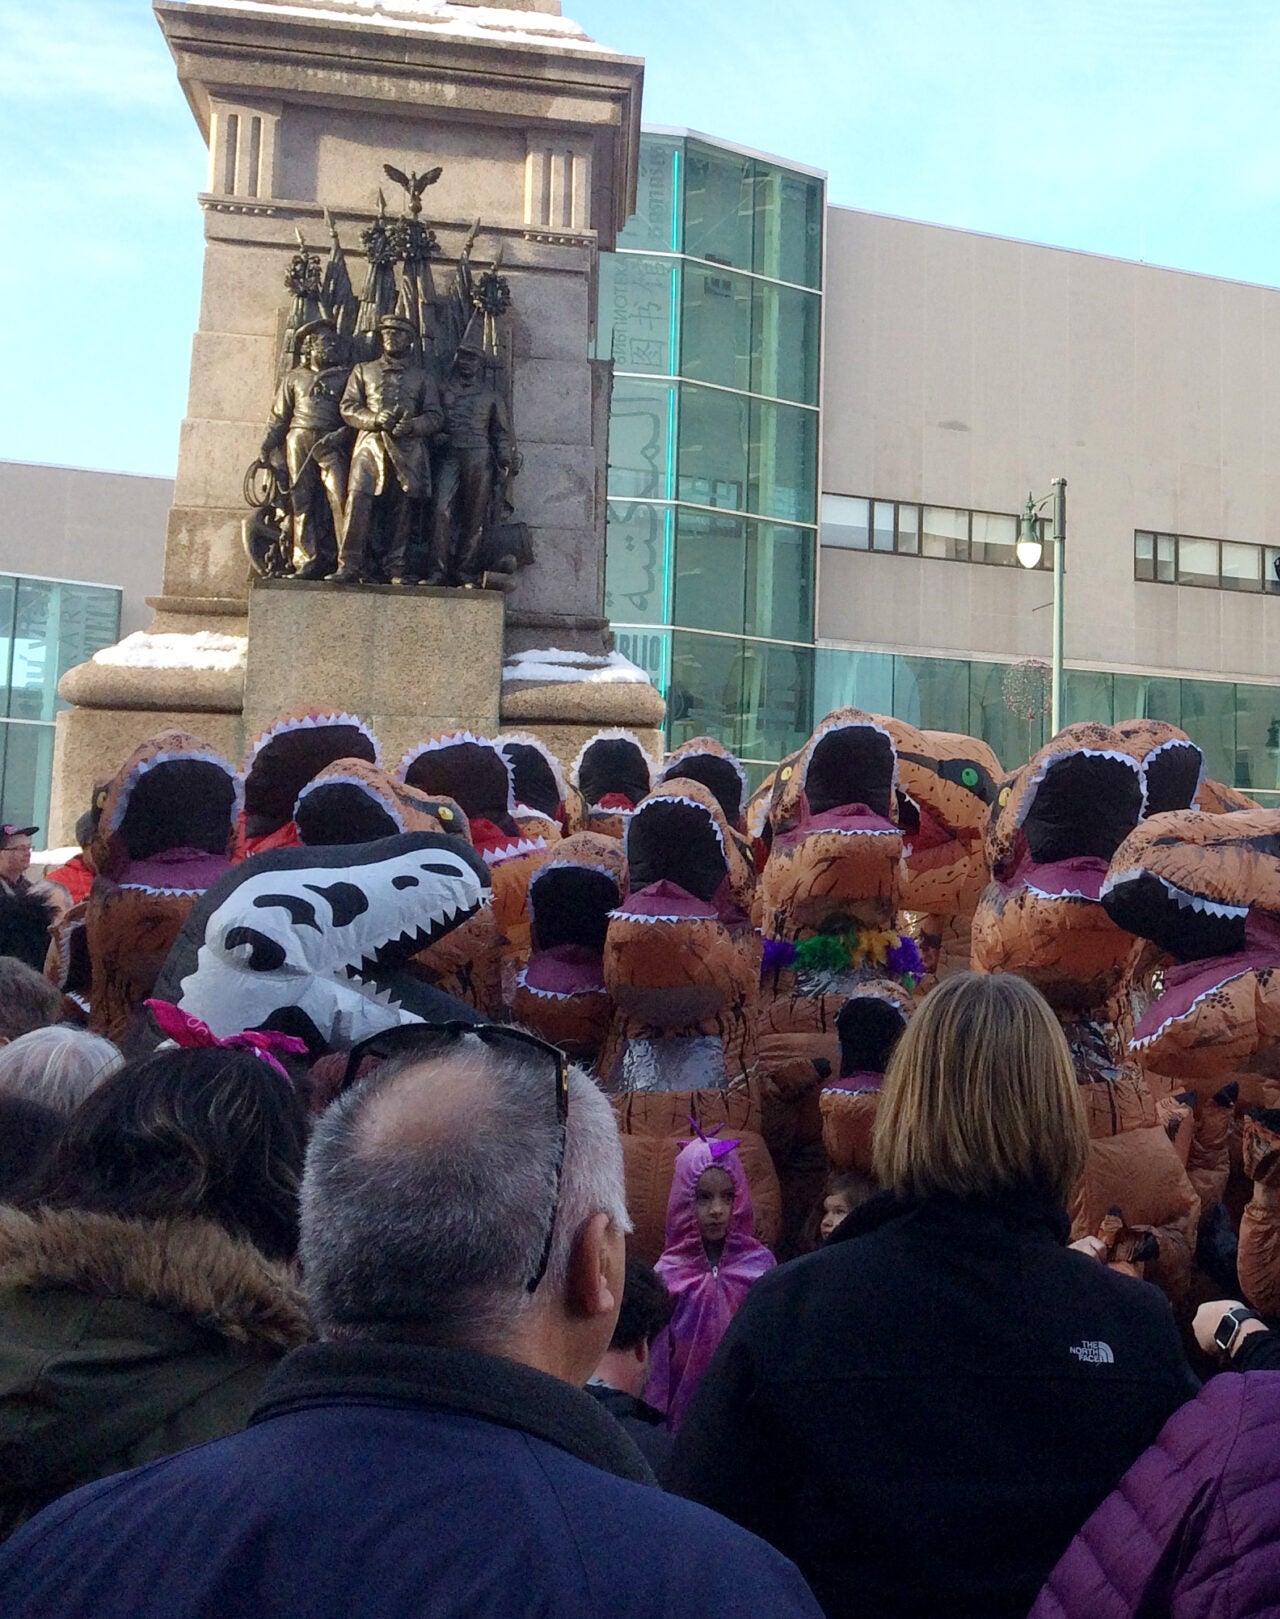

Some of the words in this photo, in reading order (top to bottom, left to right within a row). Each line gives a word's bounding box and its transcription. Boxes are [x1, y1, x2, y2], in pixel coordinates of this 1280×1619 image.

[1081, 1340, 1099, 1349] THE
[1069, 1346, 1099, 1356] NORTH
[1078, 1354, 1100, 1362] FACE
